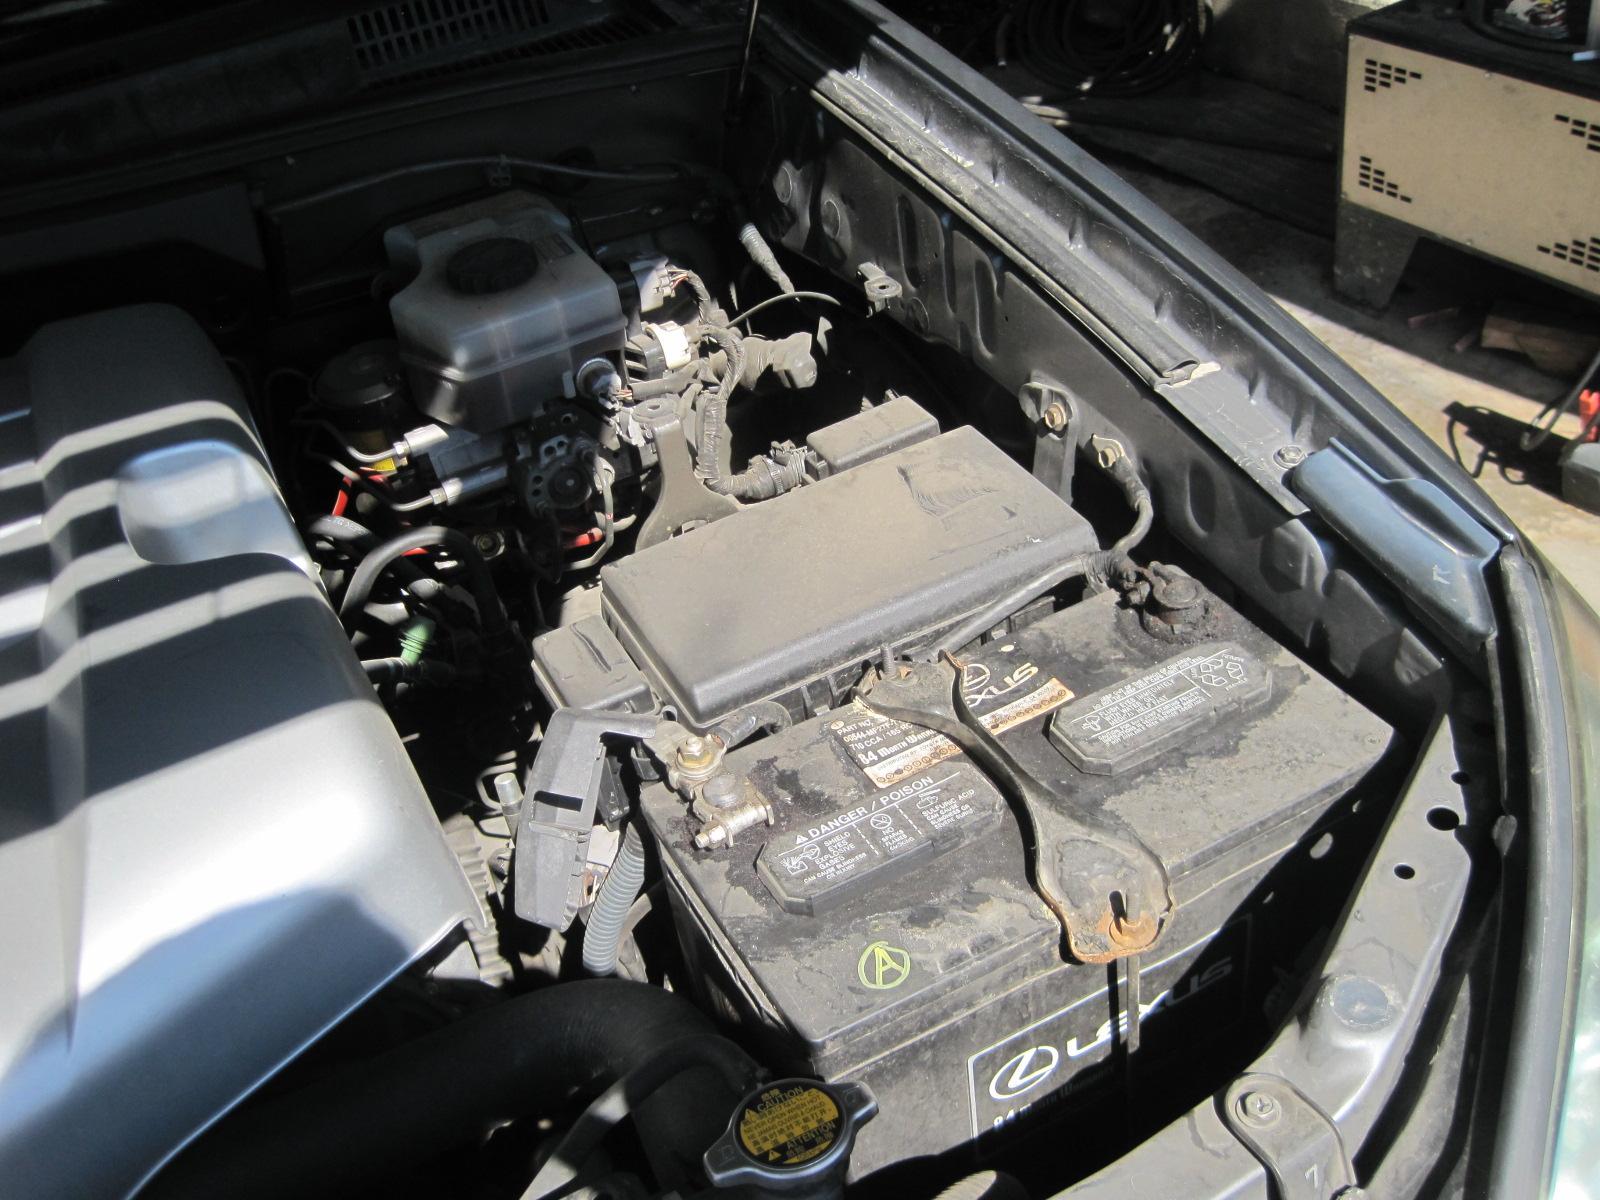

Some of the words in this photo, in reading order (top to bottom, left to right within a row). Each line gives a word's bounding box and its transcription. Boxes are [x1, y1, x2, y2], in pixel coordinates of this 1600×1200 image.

[965, 662, 1039, 708] XUS
[837, 724, 858, 736] PART
[864, 736, 883, 747] CCA
[808, 806, 868, 838] DANGER
[871, 800, 876, 811] /
[880, 776, 934, 806] POISON
[922, 797, 957, 818] SULFURIC
[957, 788, 975, 801] ACID
[939, 804, 959, 815] CAUSE
[824, 831, 851, 847] SHIELD
[881, 830, 905, 843] SPARKS
[882, 826, 895, 836] NO
[815, 843, 856, 865] EXPLOSIVE
[827, 840, 848, 852] EYES
[819, 856, 845, 870] GASES
[804, 874, 817, 884] CAN
[816, 867, 836, 878] CAUSE
[757, 1086, 804, 1112] CAUTION
[786, 1121, 836, 1149] ATTENTION
